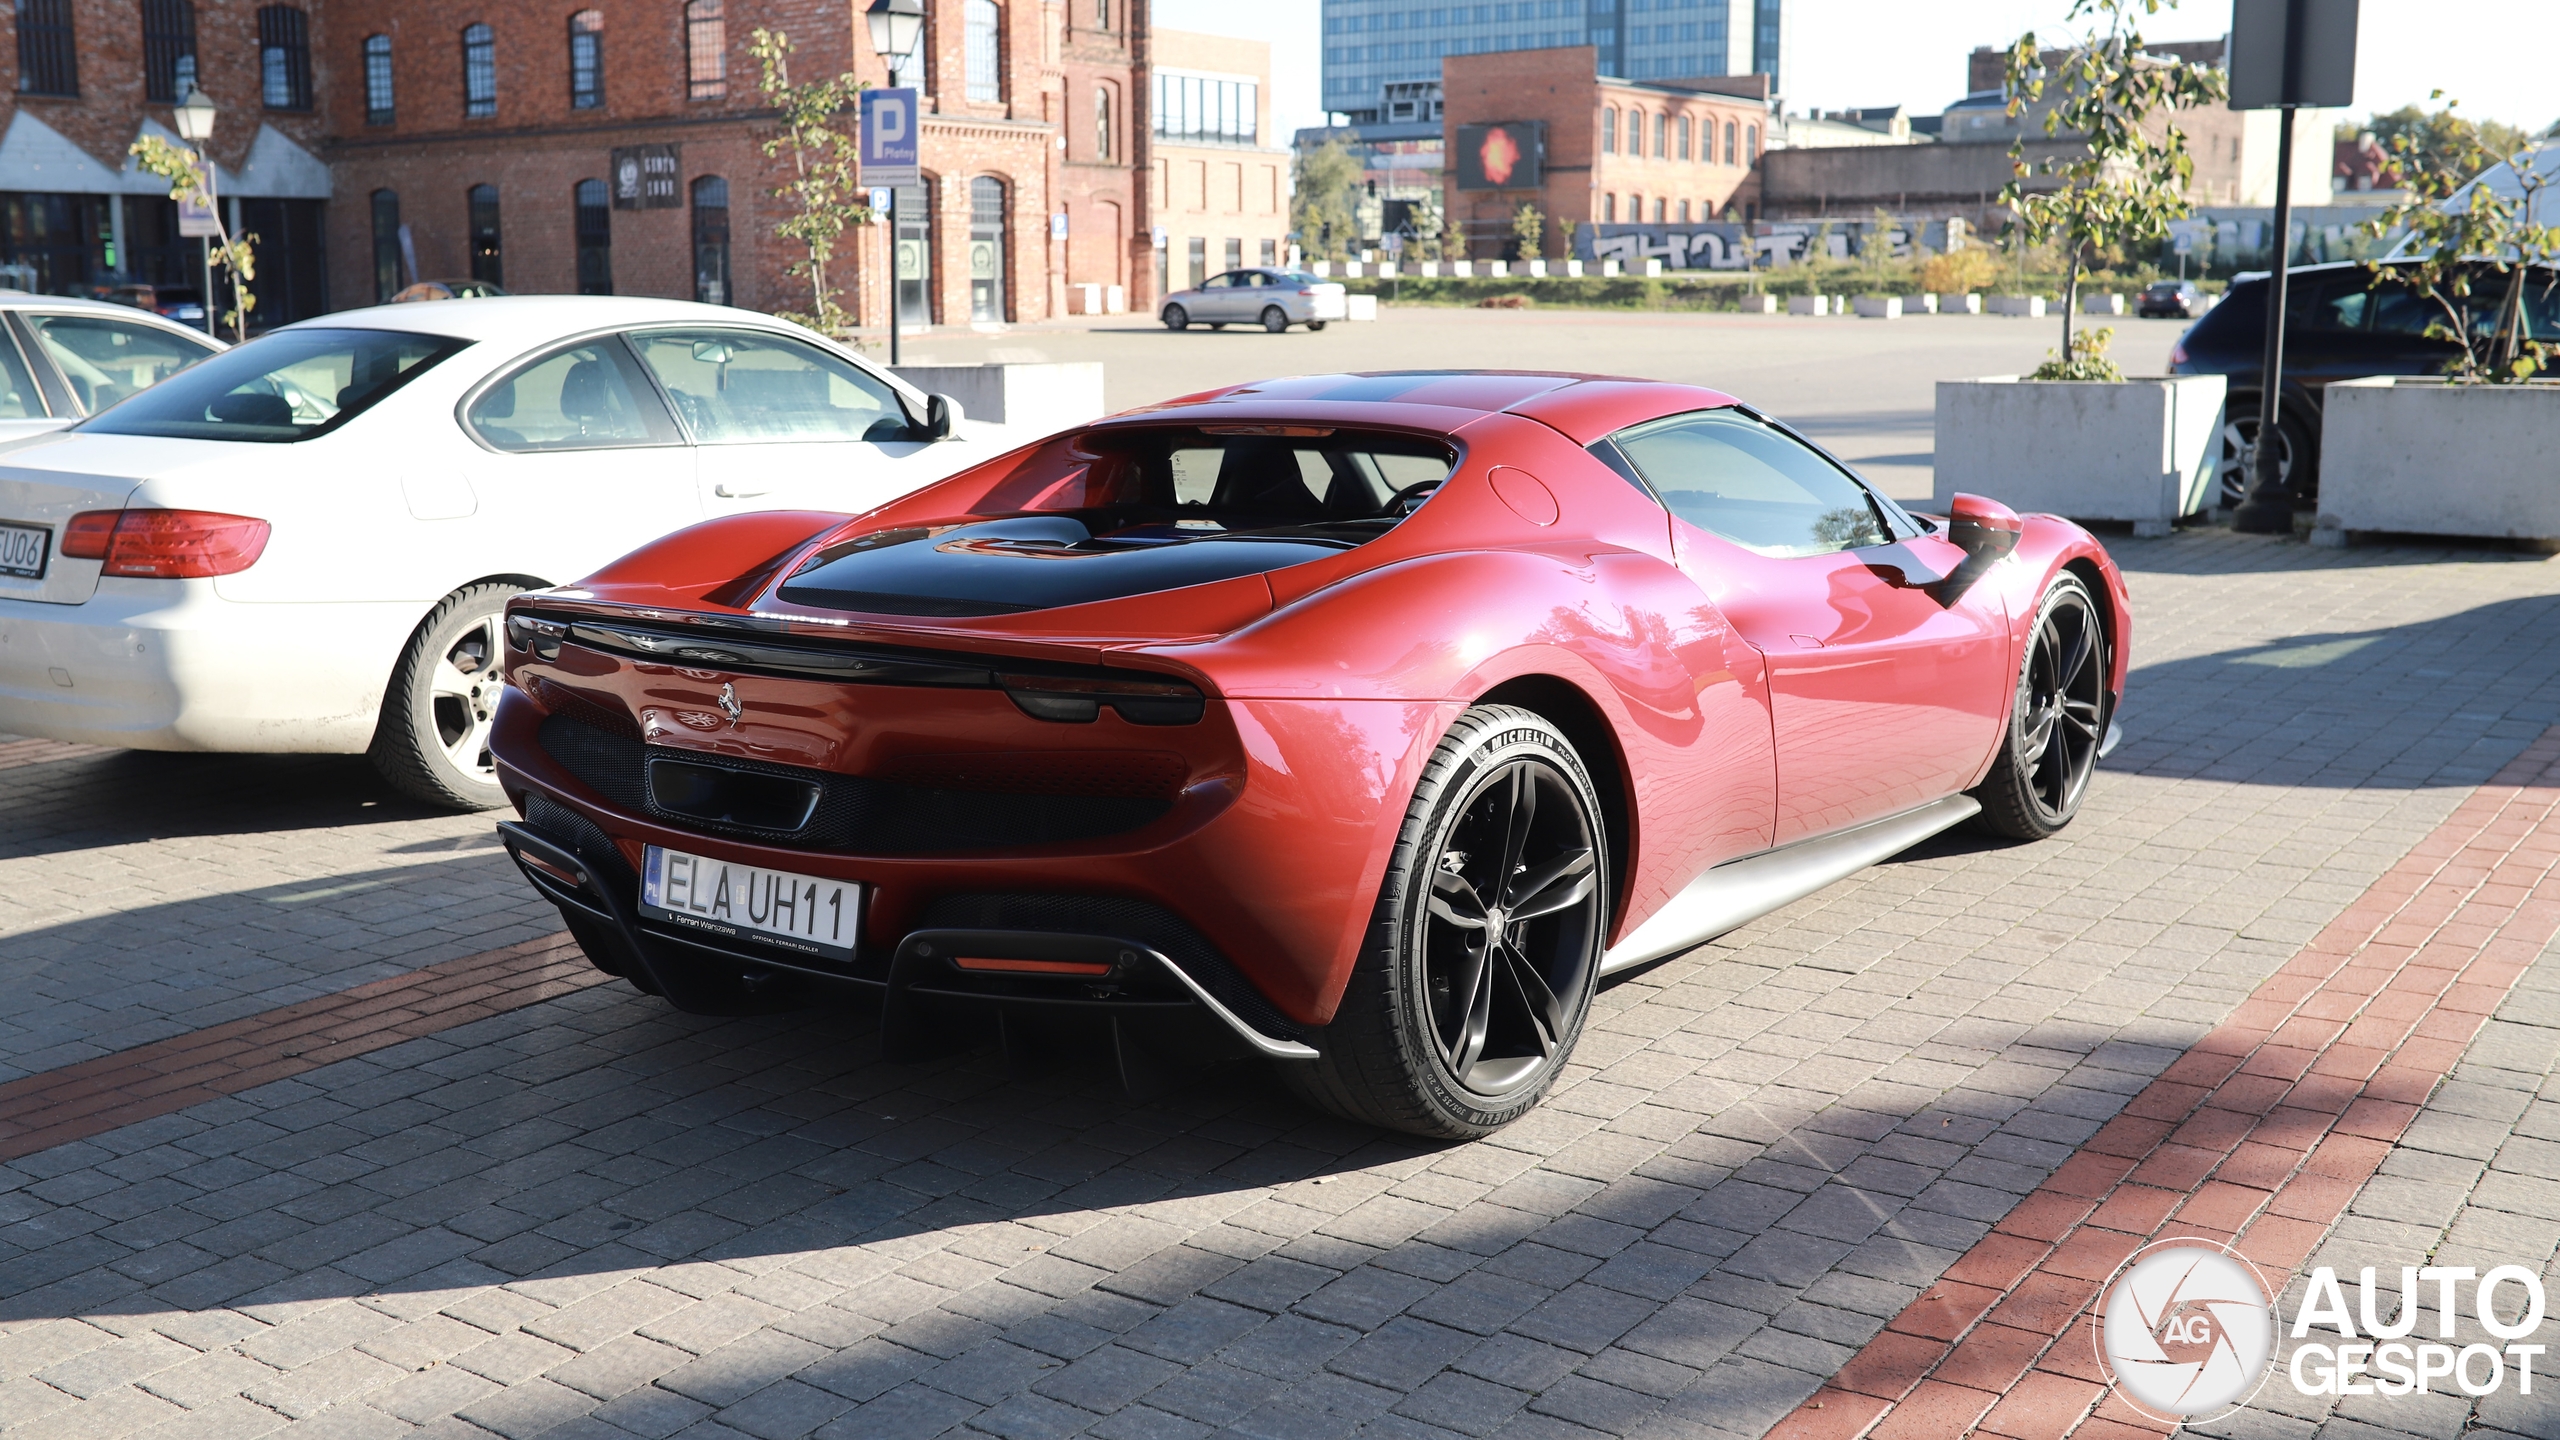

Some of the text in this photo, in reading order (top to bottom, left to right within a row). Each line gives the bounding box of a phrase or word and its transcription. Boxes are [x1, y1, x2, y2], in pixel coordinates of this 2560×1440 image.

[873, 98, 906, 160] P
[874, 190, 887, 212] P
[0, 530, 40, 566] U06
[1491, 729, 1554, 750] MICHELIN
[1557, 745, 1574, 764] PILOT
[1573, 763, 1590, 789] SPORT
[646, 883, 658, 898] PL
[666, 853, 842, 941] ELA UH11
[676, 914, 736, 936] Ferrari Warszawa
[752, 934, 819, 953] OFFICIAL FERRARI DEALER
[1427, 1073, 1438, 1086] 20
[1434, 1085, 1444, 1094] ZR
[1442, 1096, 1467, 1115] 305/35
[1468, 1095, 1536, 1125] MICHELIN
